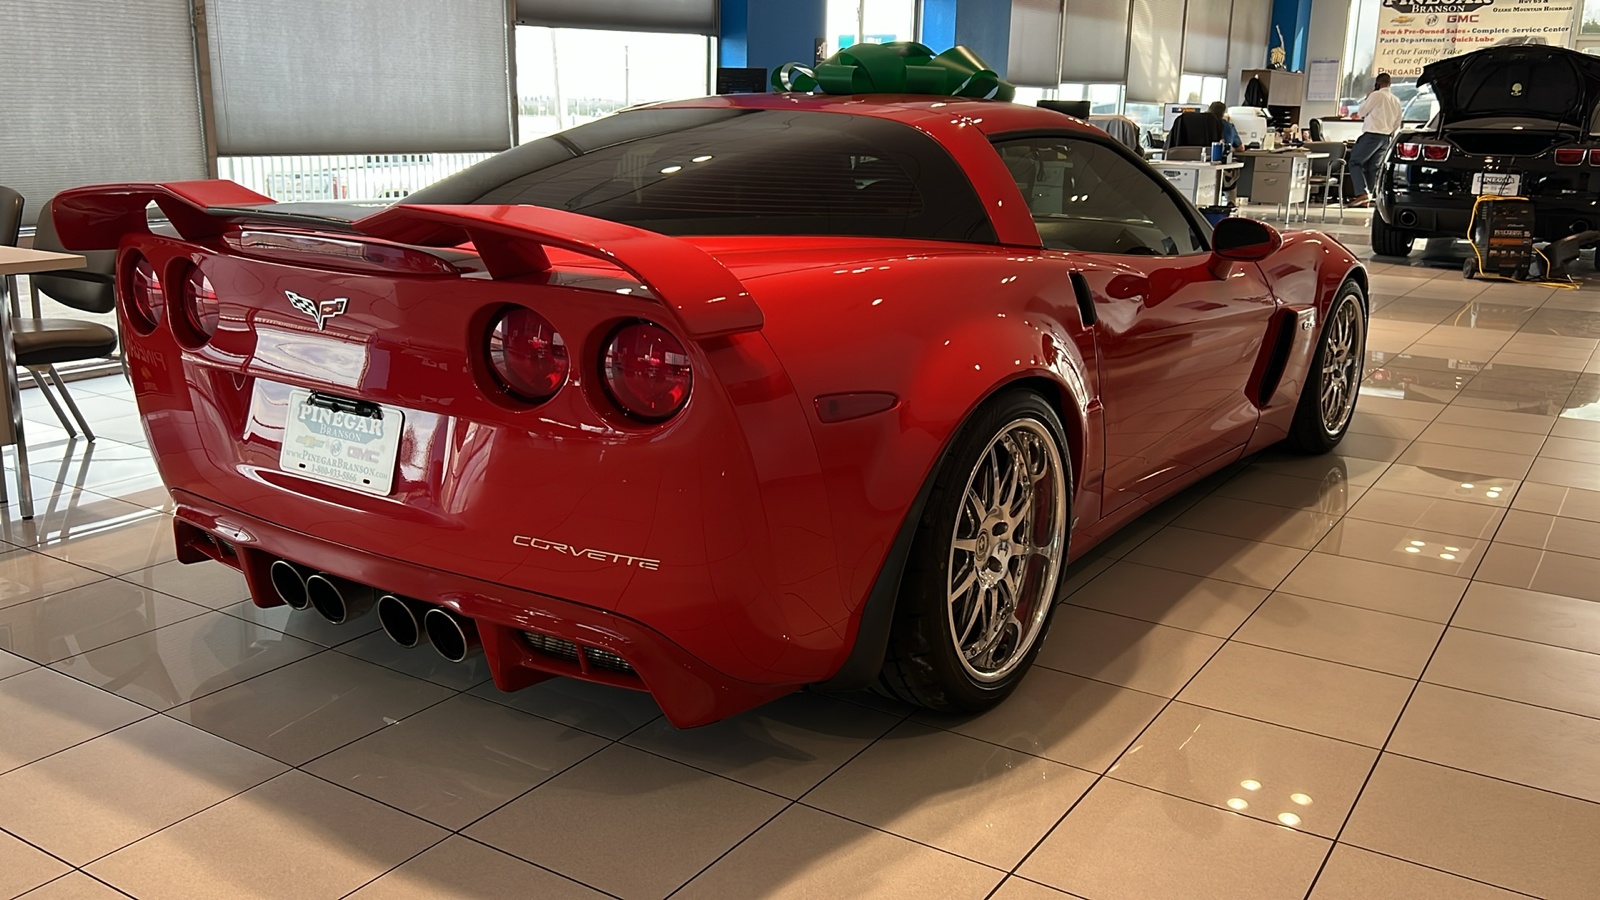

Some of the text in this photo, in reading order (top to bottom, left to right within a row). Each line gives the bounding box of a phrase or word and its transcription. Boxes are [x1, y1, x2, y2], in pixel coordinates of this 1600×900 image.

[1411, 5, 1466, 13] BRANSON
[1447, 15, 1479, 23] GMC
[1413, 48, 1440, 56] Family
[1413, 57, 1422, 65] of
[299, 404, 382, 436] PINEGAR
[319, 423, 362, 442] BRANSON
[347, 446, 380, 464] GMC
[512, 535, 660, 571] CORVETTE
